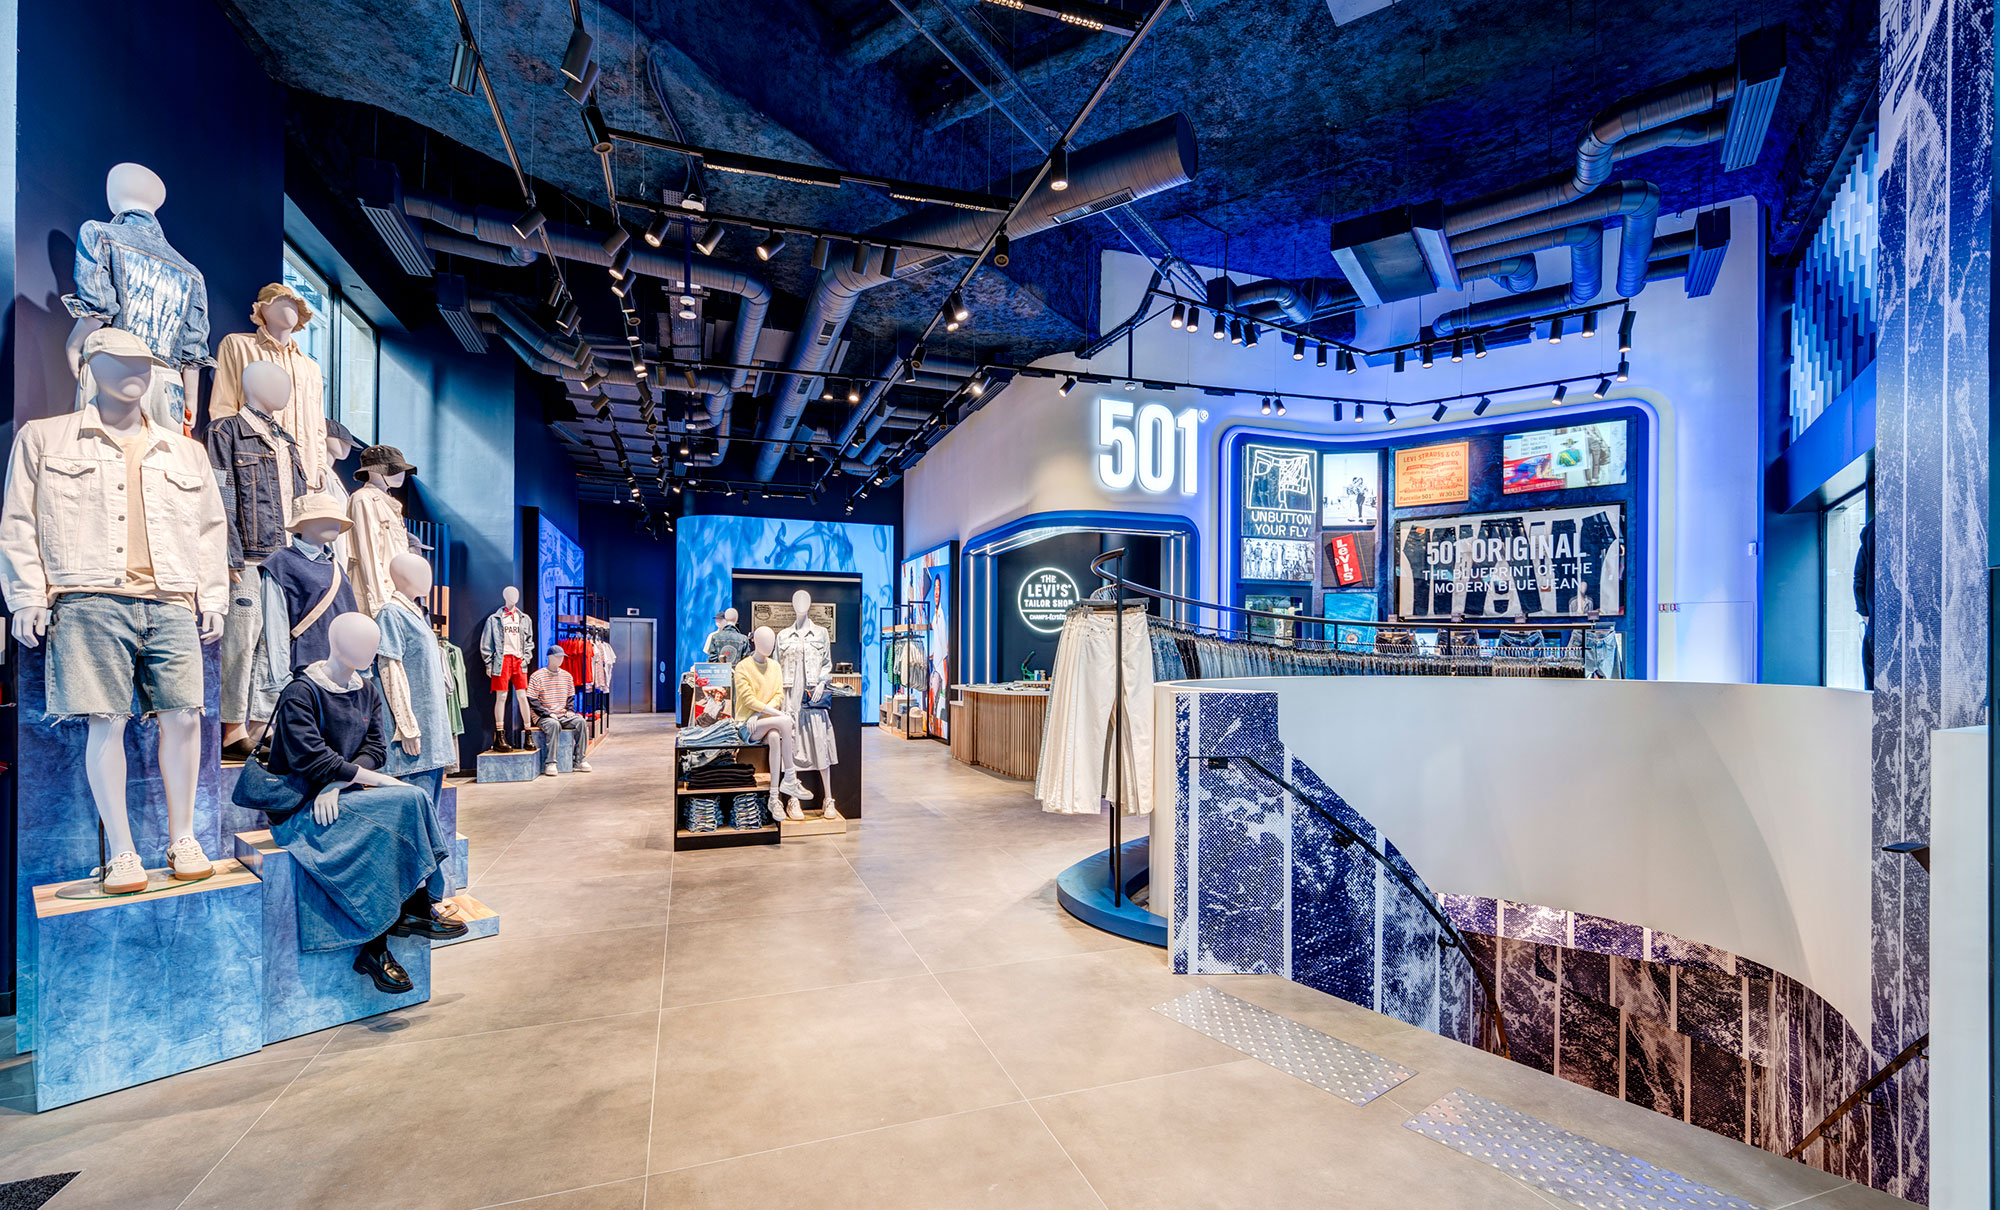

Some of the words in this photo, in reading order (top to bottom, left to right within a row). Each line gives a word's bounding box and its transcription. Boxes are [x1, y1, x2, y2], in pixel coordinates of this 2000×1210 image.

[1418, 452, 1444, 461] STRAUSS
[1251, 510, 1312, 525] UNBUTTON
[1255, 524, 1286, 536] YOUR
[1290, 526, 1309, 538] FLY
[1427, 540, 1461, 565] 501
[1472, 532, 1587, 563] ORIGINAL
[1040, 574, 1057, 583] THE
[1422, 569, 1449, 581] THE
[1453, 565, 1533, 580] BLUEPRINT
[1537, 563, 1558, 576] OF
[1561, 562, 1593, 575] THE
[1435, 580, 1493, 594] MODERN
[1498, 579, 1537, 592] BLUE
[1540, 577, 1582, 590] JEAN
[1024, 599, 1051, 608] TAILOR
